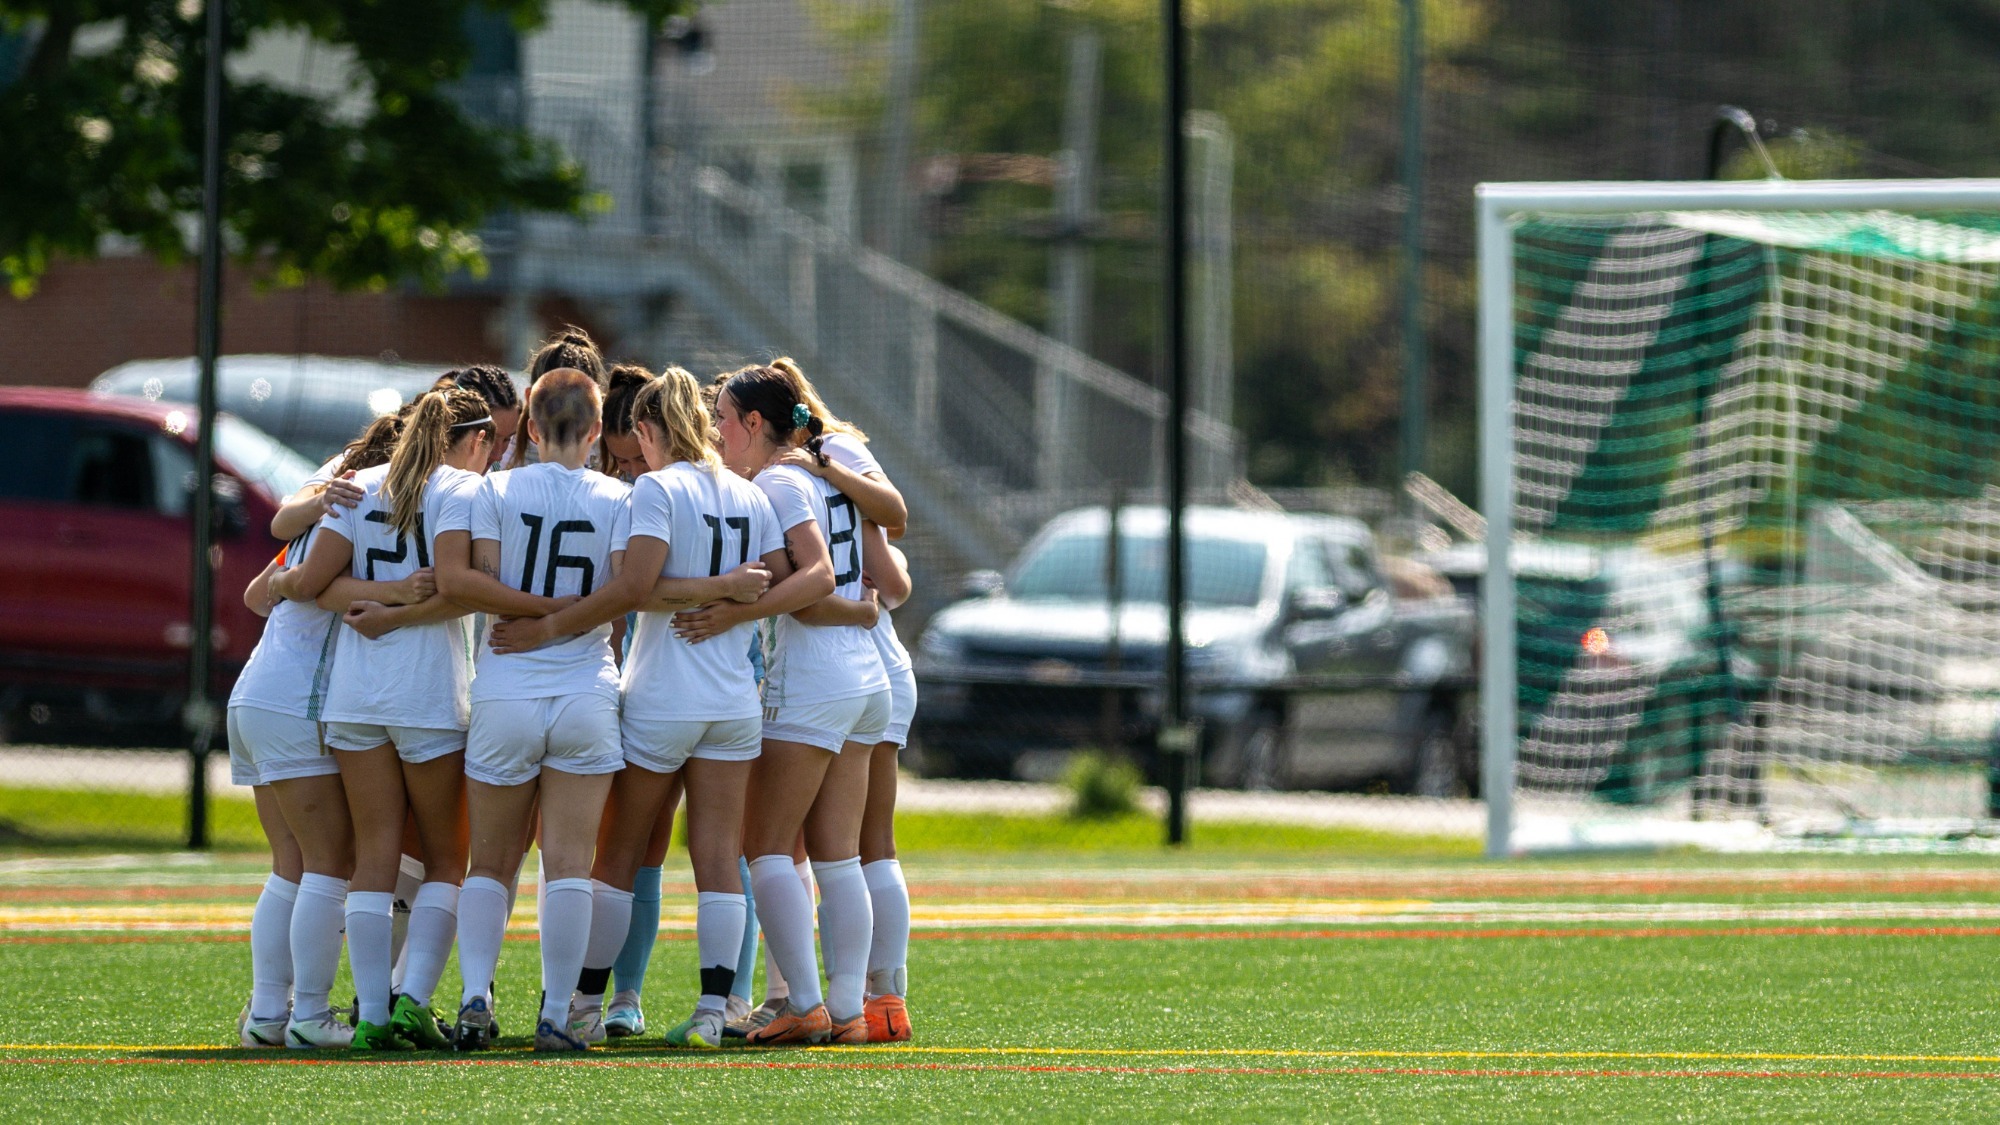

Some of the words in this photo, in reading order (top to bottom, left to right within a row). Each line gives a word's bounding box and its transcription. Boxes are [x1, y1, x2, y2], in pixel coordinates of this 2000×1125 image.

[365, 510, 430, 581] 21
[520, 512, 595, 598] 16
[825, 493, 861, 587] 8
